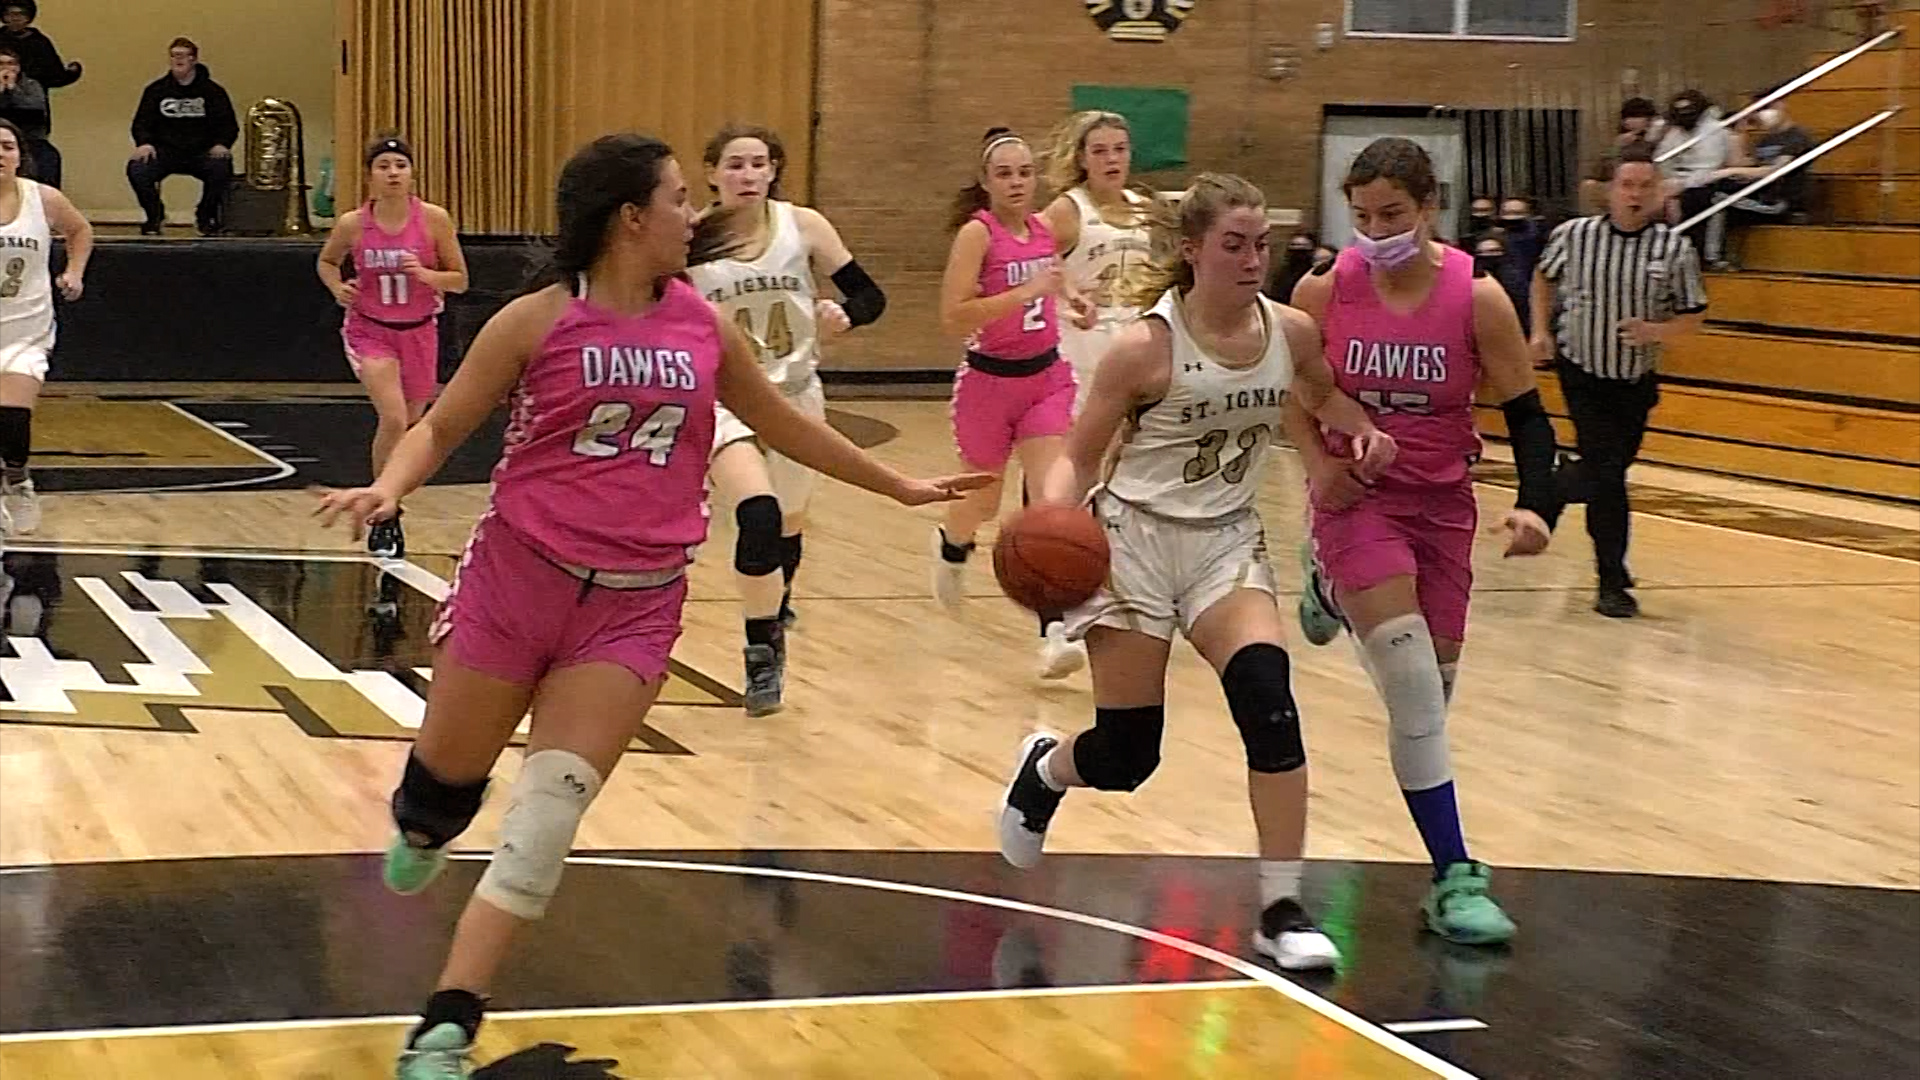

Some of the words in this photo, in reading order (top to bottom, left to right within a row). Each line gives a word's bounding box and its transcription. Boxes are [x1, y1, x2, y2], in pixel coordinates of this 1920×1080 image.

[378, 273, 409, 305] 11
[1022, 297, 1047, 332] 2
[582, 347, 696, 391] DAWGS
[1344, 338, 1447, 382] DAWGS
[1180, 400, 1217, 424] ST.
[1225, 387, 1291, 411] IGNAC
[571, 402, 688, 467] 24
